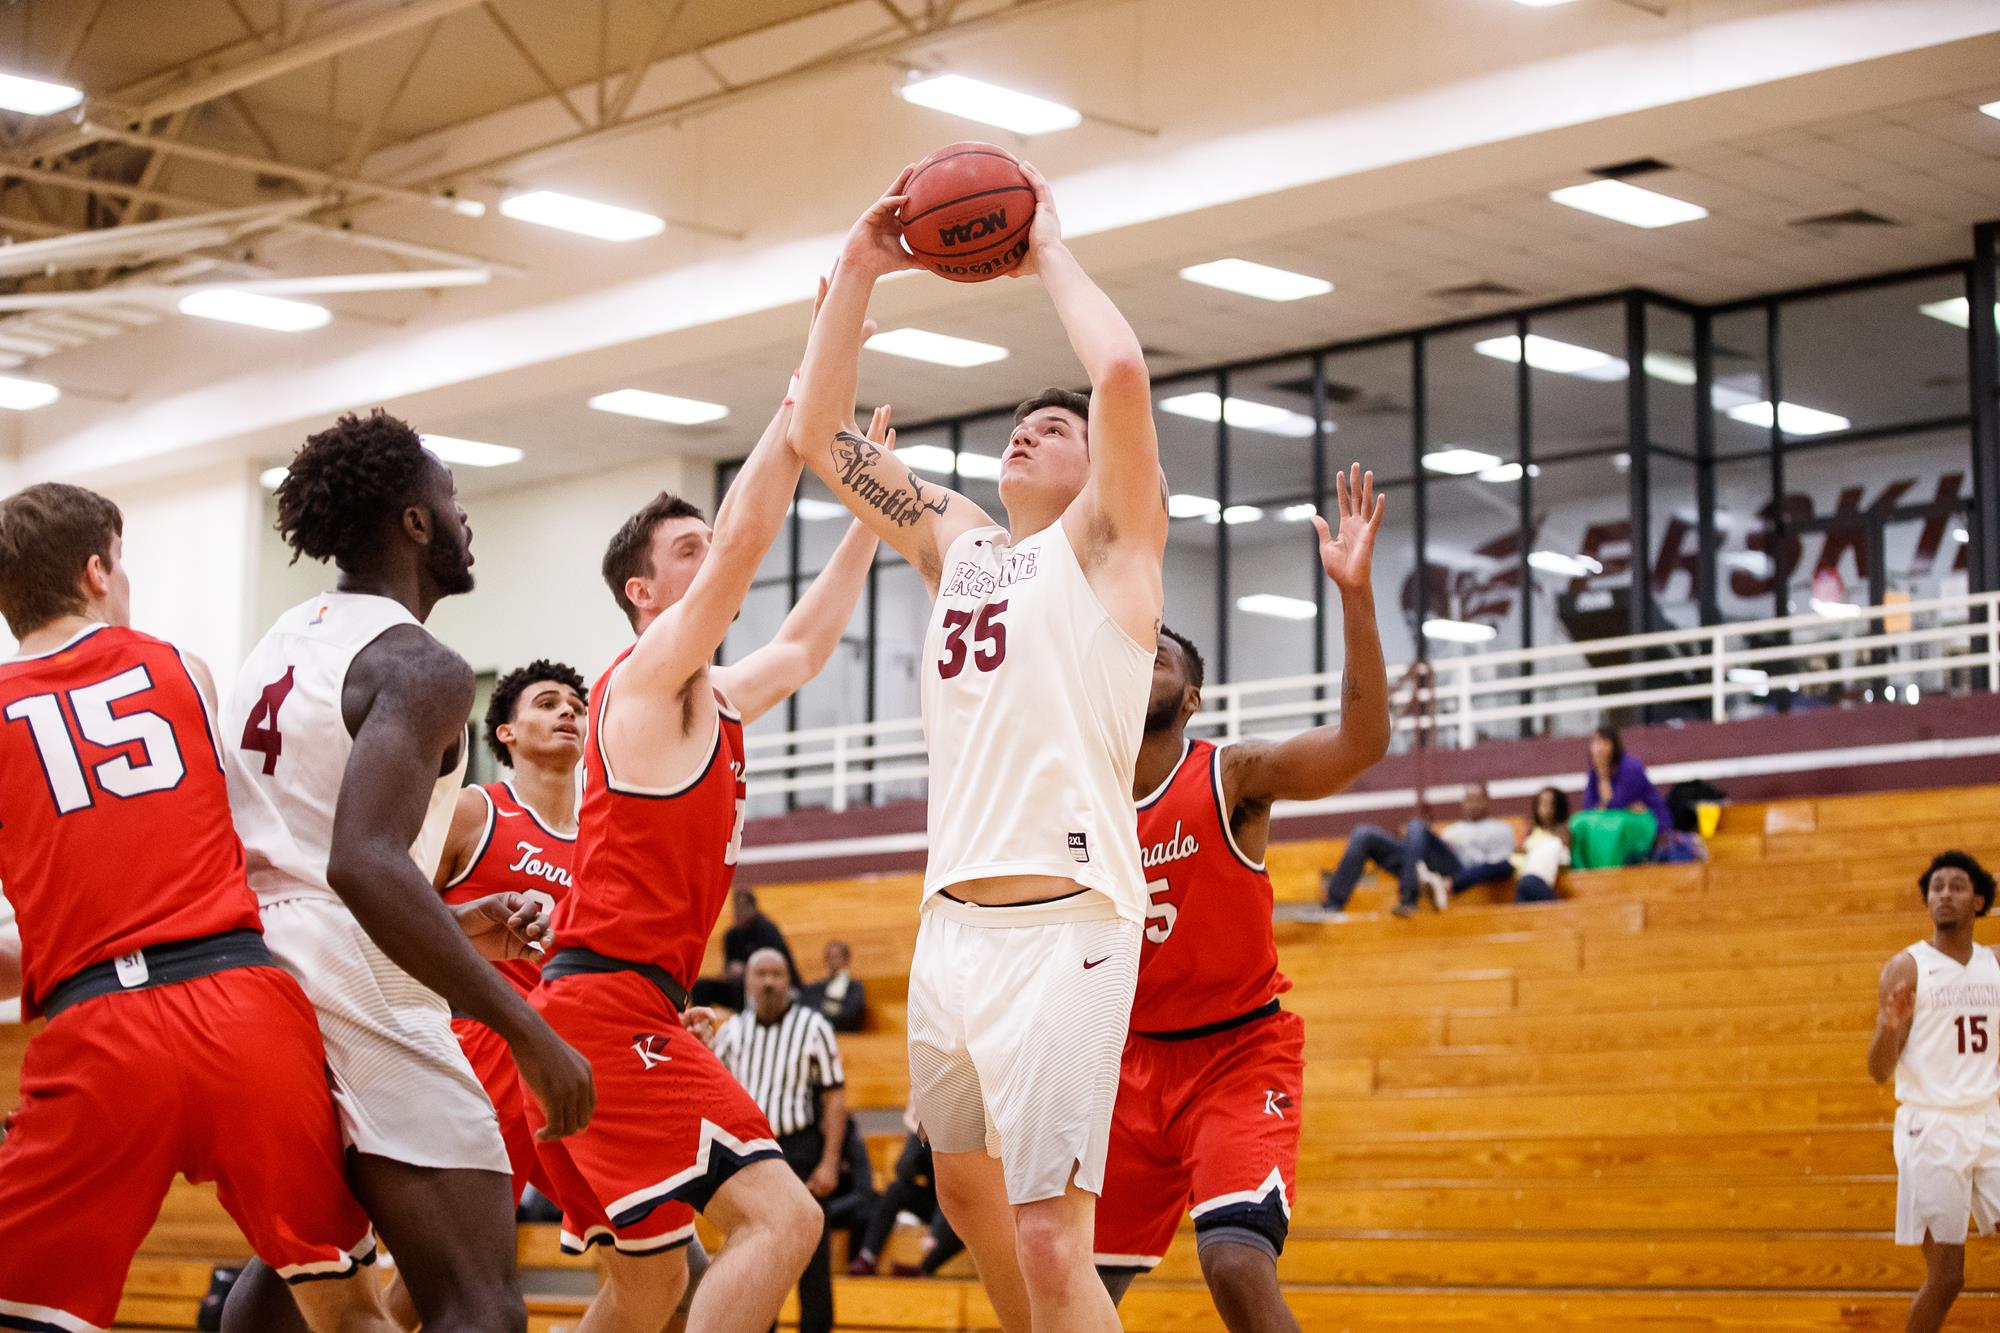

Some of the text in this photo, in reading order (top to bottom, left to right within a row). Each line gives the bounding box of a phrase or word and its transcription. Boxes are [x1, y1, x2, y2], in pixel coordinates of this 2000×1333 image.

[939, 208, 1007, 246] NCAA
[937, 599, 1009, 680] 35
[4, 663, 188, 816] 15
[240, 664, 296, 776] 4
[509, 841, 573, 888] Torn
[1068, 836, 1085, 846] 2XL
[1954, 1015, 1988, 1054] 15
